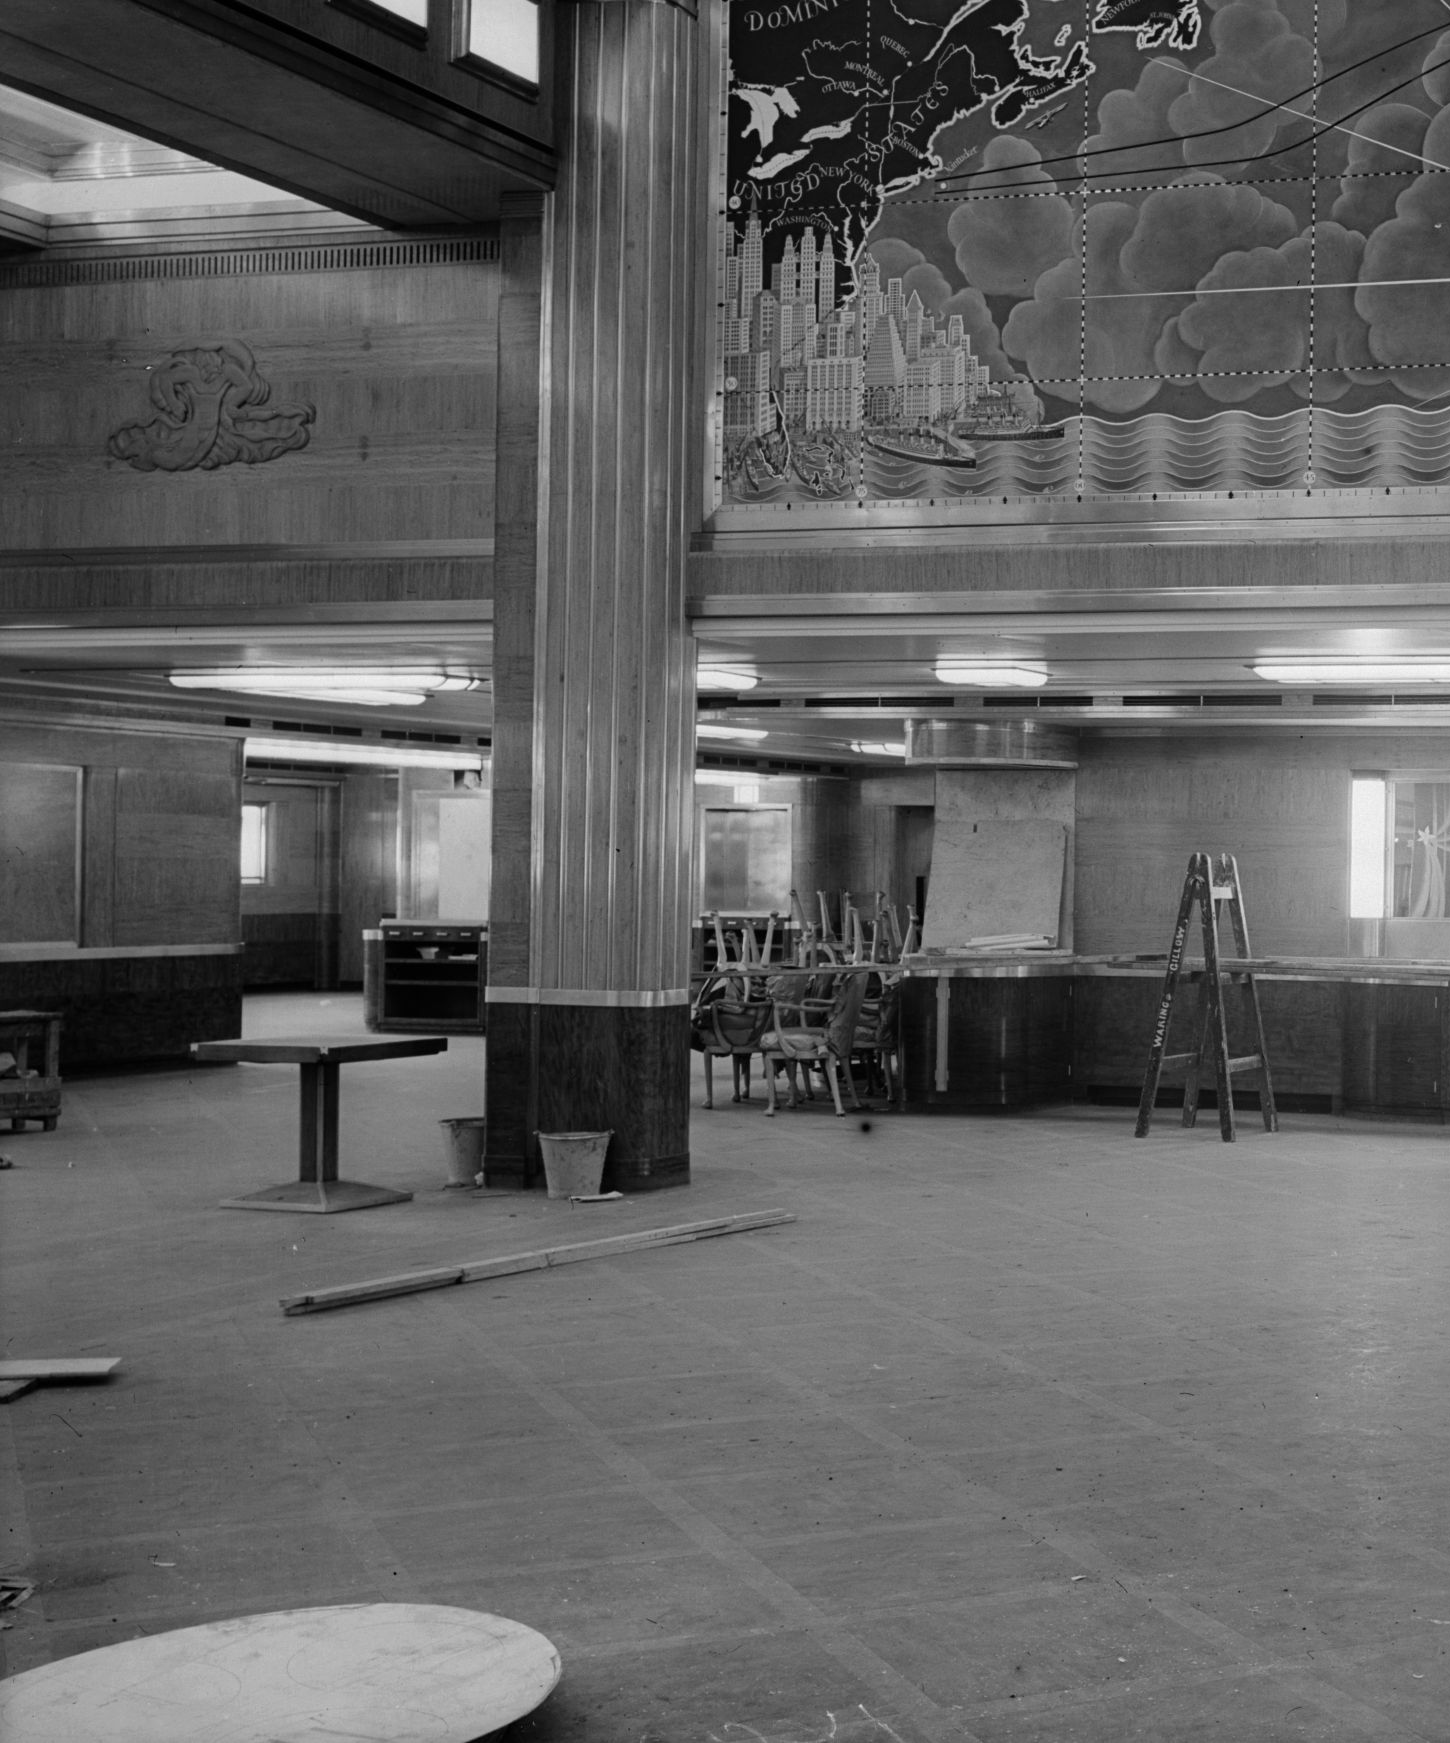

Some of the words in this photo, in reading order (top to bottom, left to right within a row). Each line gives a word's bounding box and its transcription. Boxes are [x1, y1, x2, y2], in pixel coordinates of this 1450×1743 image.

[880, 35, 910, 58] QUEBEC
[844, 61, 885, 87] MONTREAL
[821, 80, 856, 94] OTTAWA
[1025, 82, 1056, 98] HALIFAX
[733, 170, 820, 201] UNITED
[866, 80, 949, 163] STATES
[891, 134, 922, 158] BOSTON
[943, 145, 978, 173] Nantucket
[820, 165, 846, 178] NEW
[848, 170, 876, 197] YORK
[776, 215, 834, 233] WASHINGTON
[1153, 1000, 1170, 1048] WARING
[1169, 925, 1186, 972] GILLOW
